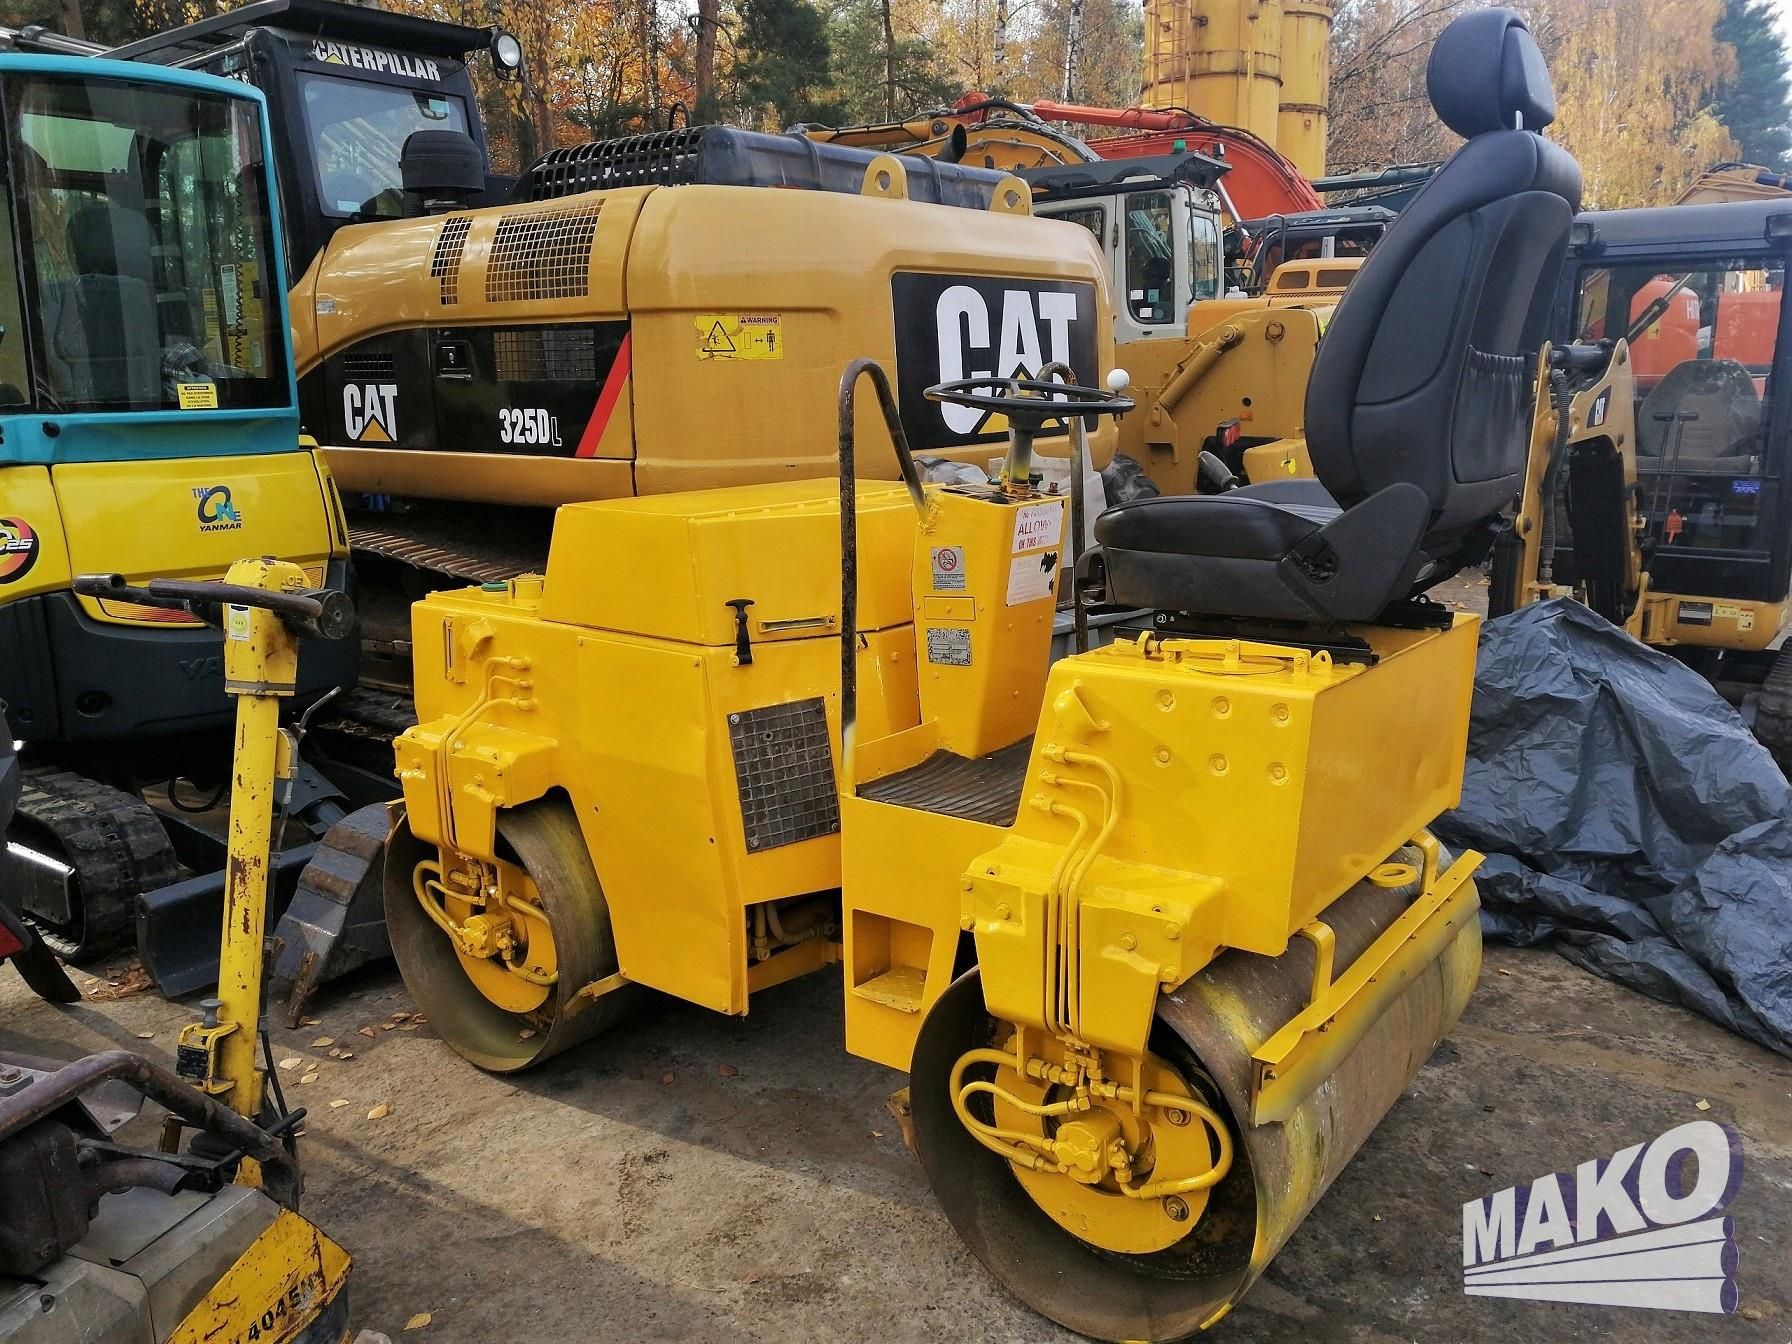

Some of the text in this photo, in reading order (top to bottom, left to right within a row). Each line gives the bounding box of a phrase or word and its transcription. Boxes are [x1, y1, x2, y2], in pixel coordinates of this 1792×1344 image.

[313, 40, 441, 81] CATERPILLAR
[747, 316, 778, 324] WARNING
[937, 285, 1078, 435] CAT
[343, 383, 398, 442] CAT
[200, 523, 242, 532] YANMAR
